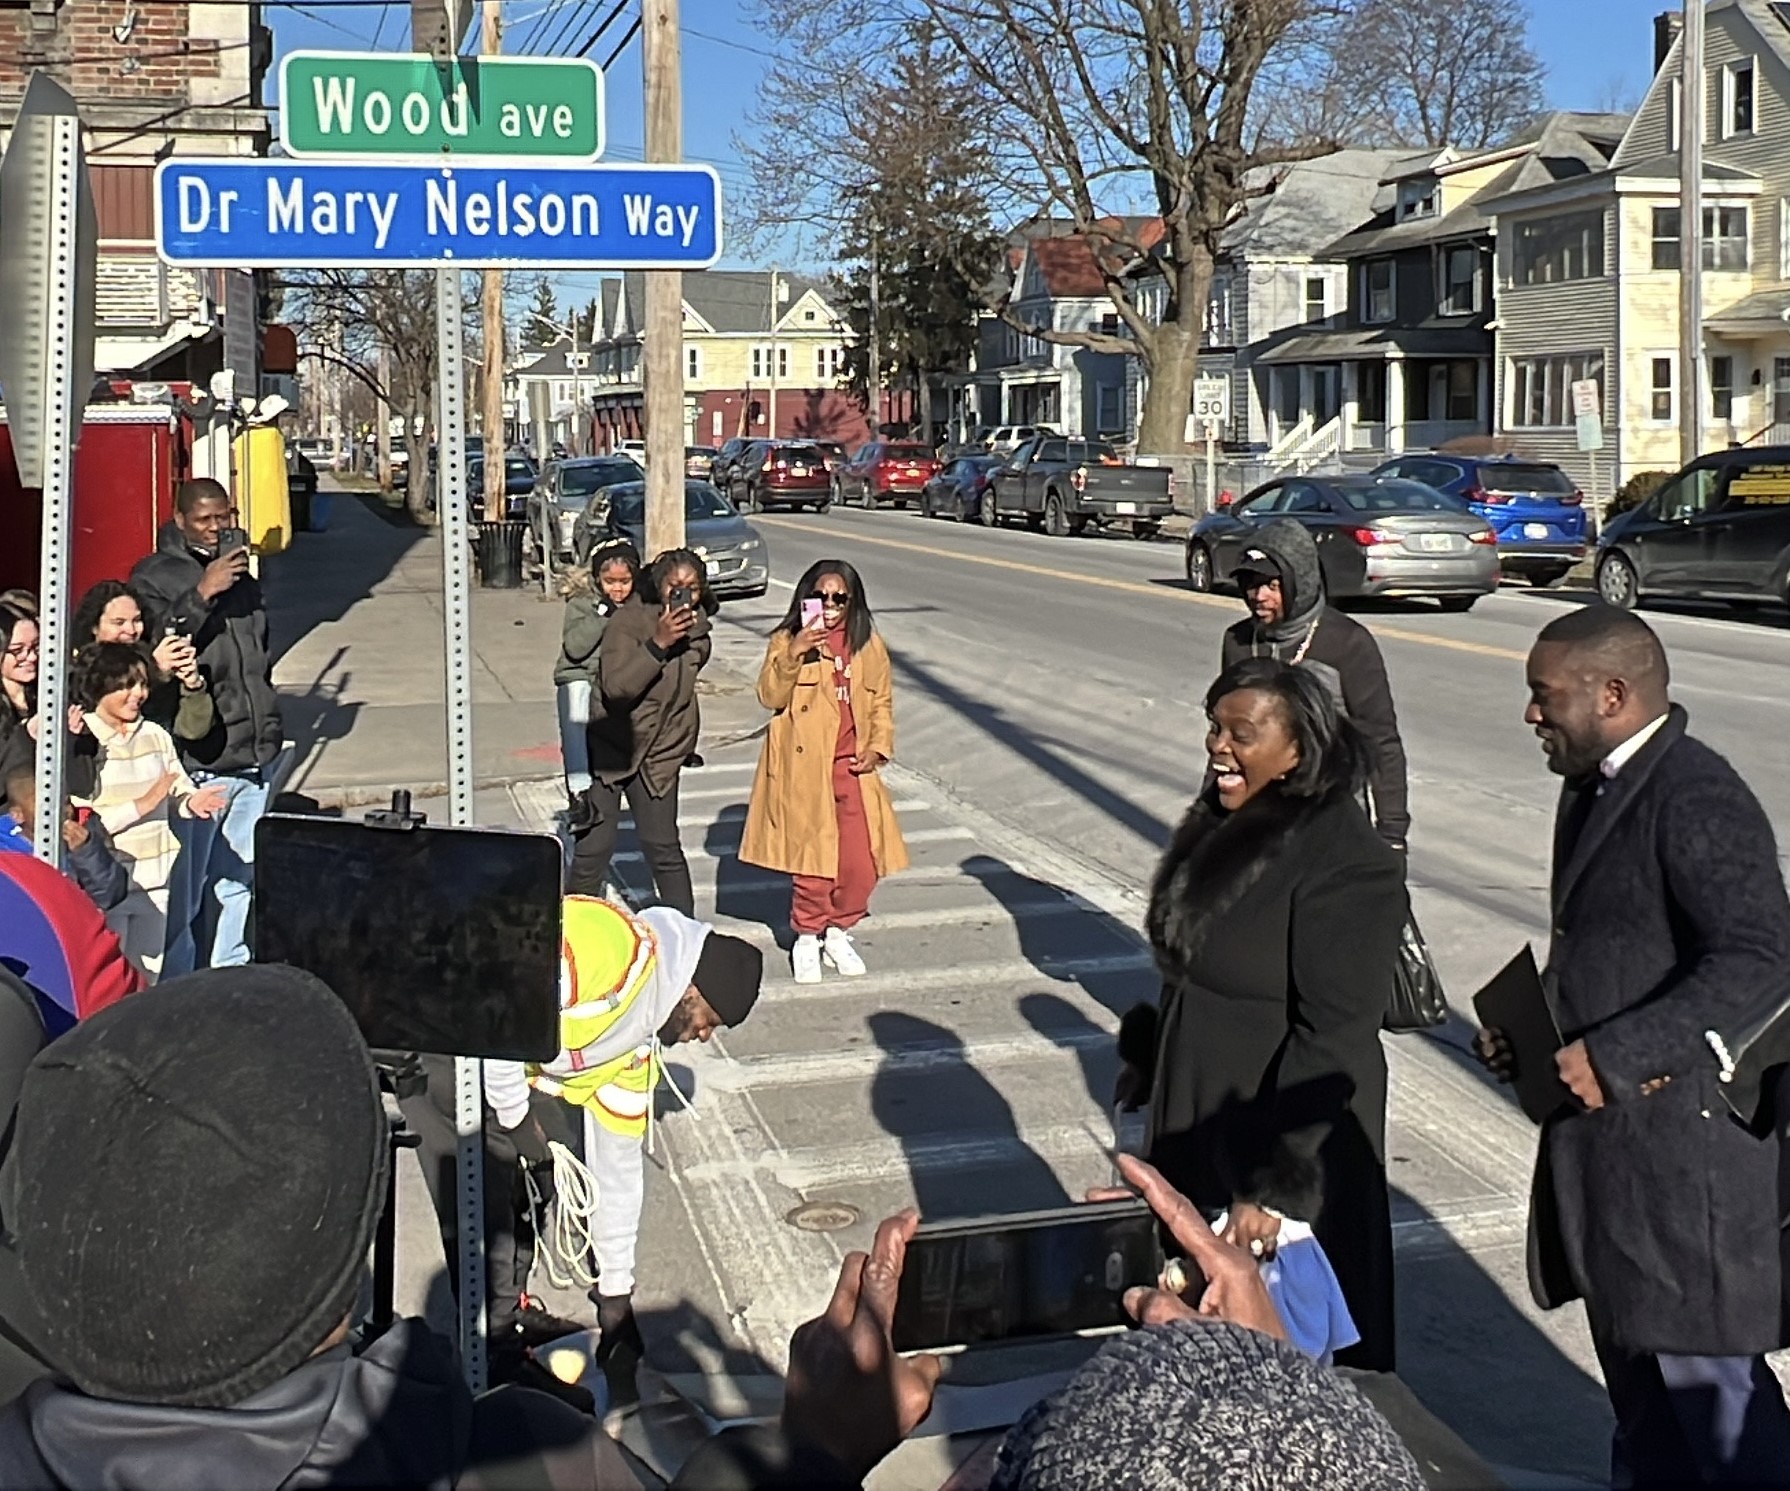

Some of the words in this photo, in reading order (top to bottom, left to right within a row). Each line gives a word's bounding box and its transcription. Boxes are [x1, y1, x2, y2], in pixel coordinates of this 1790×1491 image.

[312, 76, 468, 136] Wood
[500, 103, 573, 138] ave
[178, 176, 238, 233] Dr
[267, 177, 399, 249] Mary
[426, 178, 599, 237] Nelson
[623, 194, 699, 247] Way
[1198, 400, 1223, 415] 30
